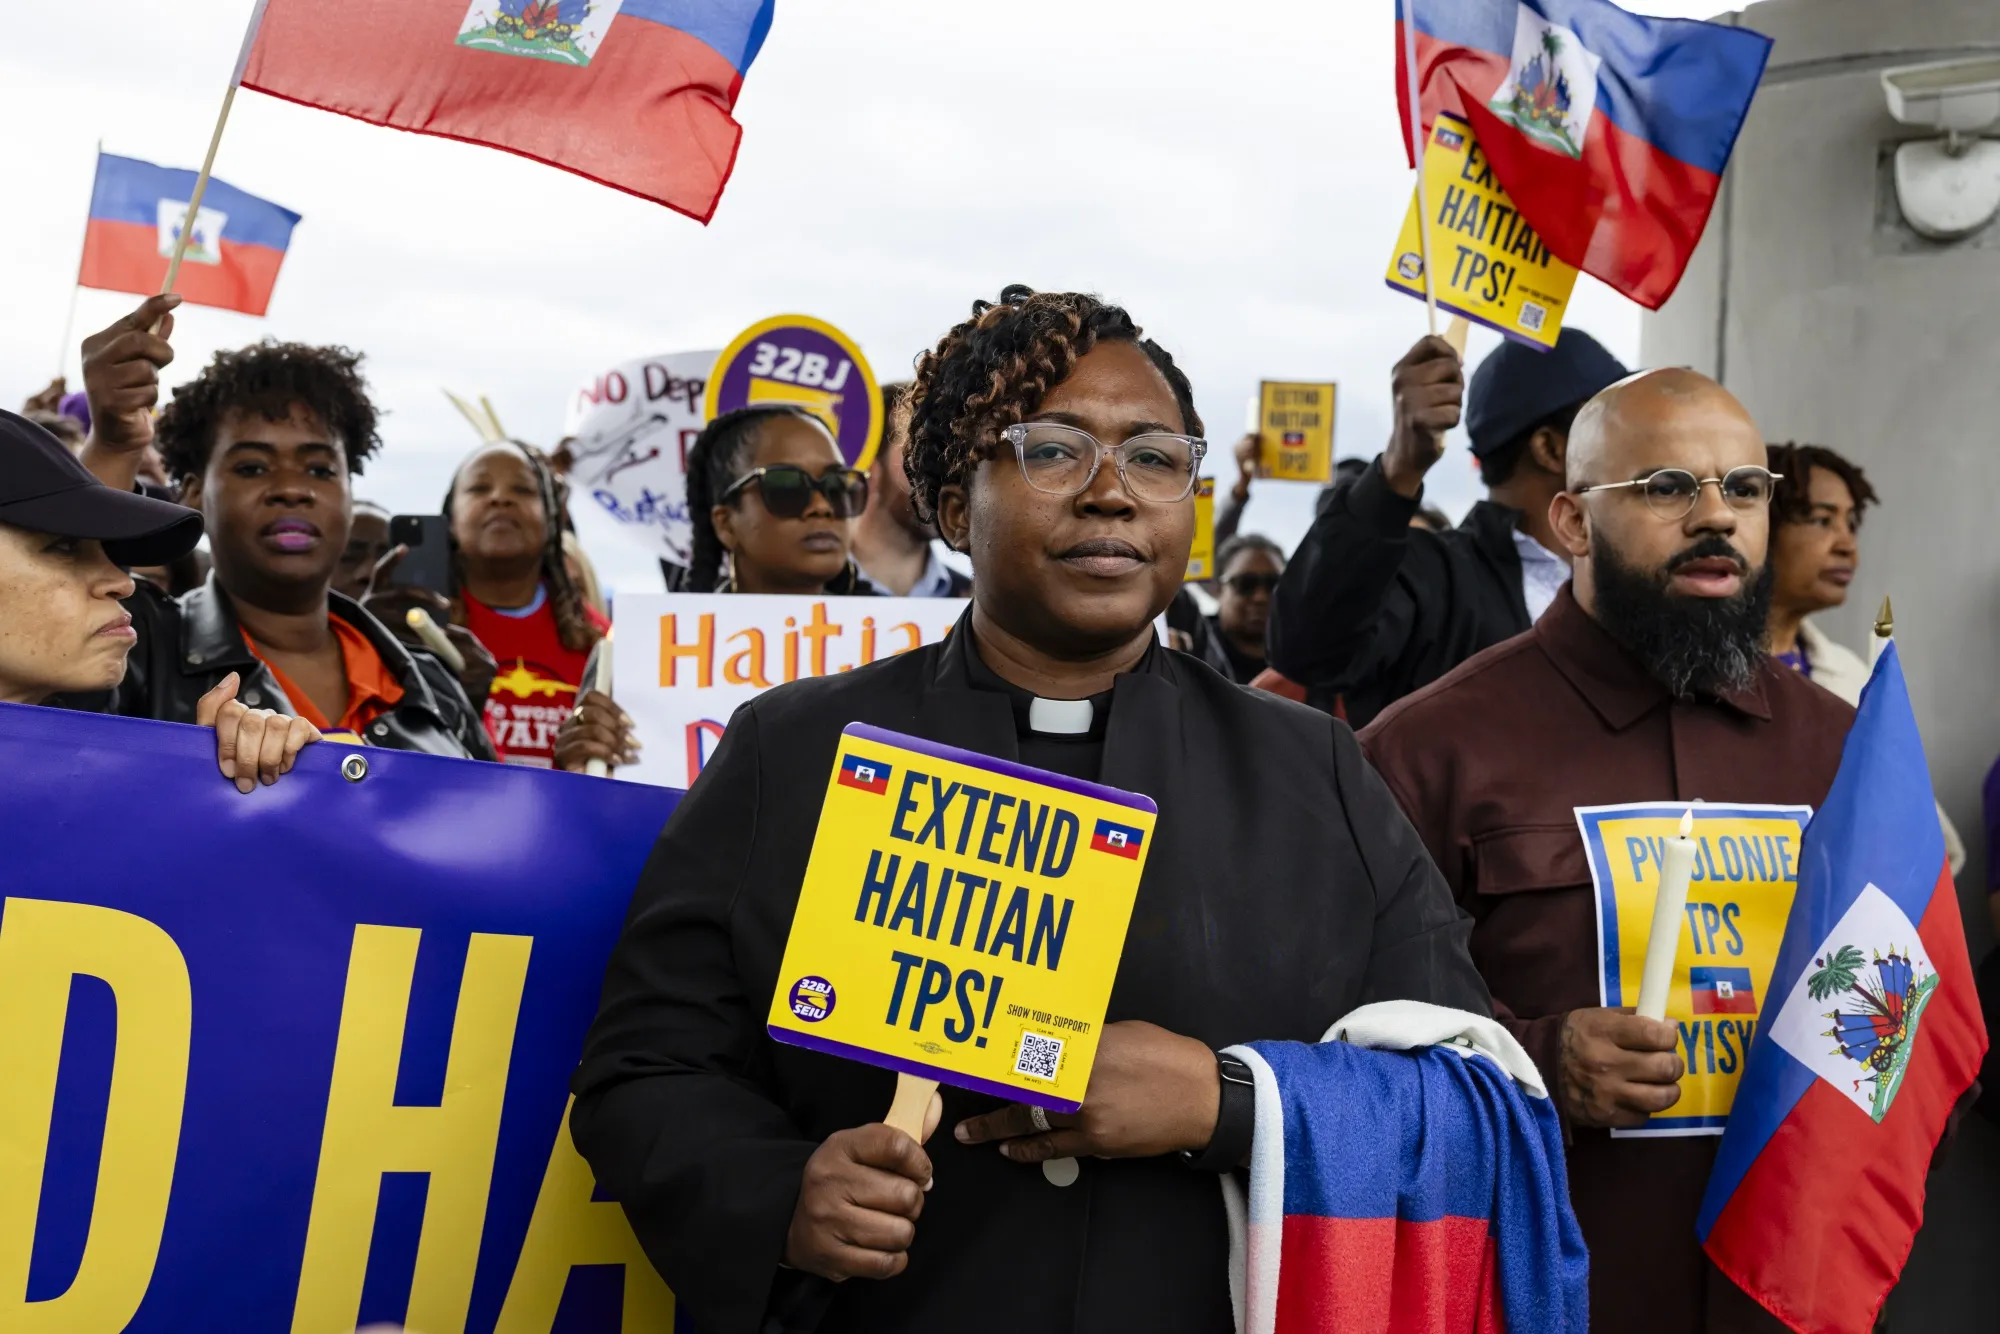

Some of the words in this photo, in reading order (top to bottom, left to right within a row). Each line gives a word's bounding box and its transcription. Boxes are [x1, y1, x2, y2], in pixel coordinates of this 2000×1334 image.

[1437, 183, 1551, 269] HAITIAN
[1450, 245, 1517, 307] TPS!
[577, 369, 629, 414] NO
[748, 341, 852, 391] 32BJ
[659, 602, 957, 688] Haitia
[890, 769, 1080, 878] EXTEND
[854, 849, 1075, 971] HAITIAN
[1684, 902, 1745, 957] TPS
[793, 1003, 827, 1019] SEIU
[799, 978, 832, 994] 32BJ
[885, 950, 1004, 1048] TPS!
[1006, 1003, 1031, 1019] SHOW
[1032, 1009, 1053, 1024] YOUR
[1052, 1015, 1091, 1035] SUPPORT!
[1669, 1019, 1754, 1075] YISY
[0, 897, 192, 1334] D
